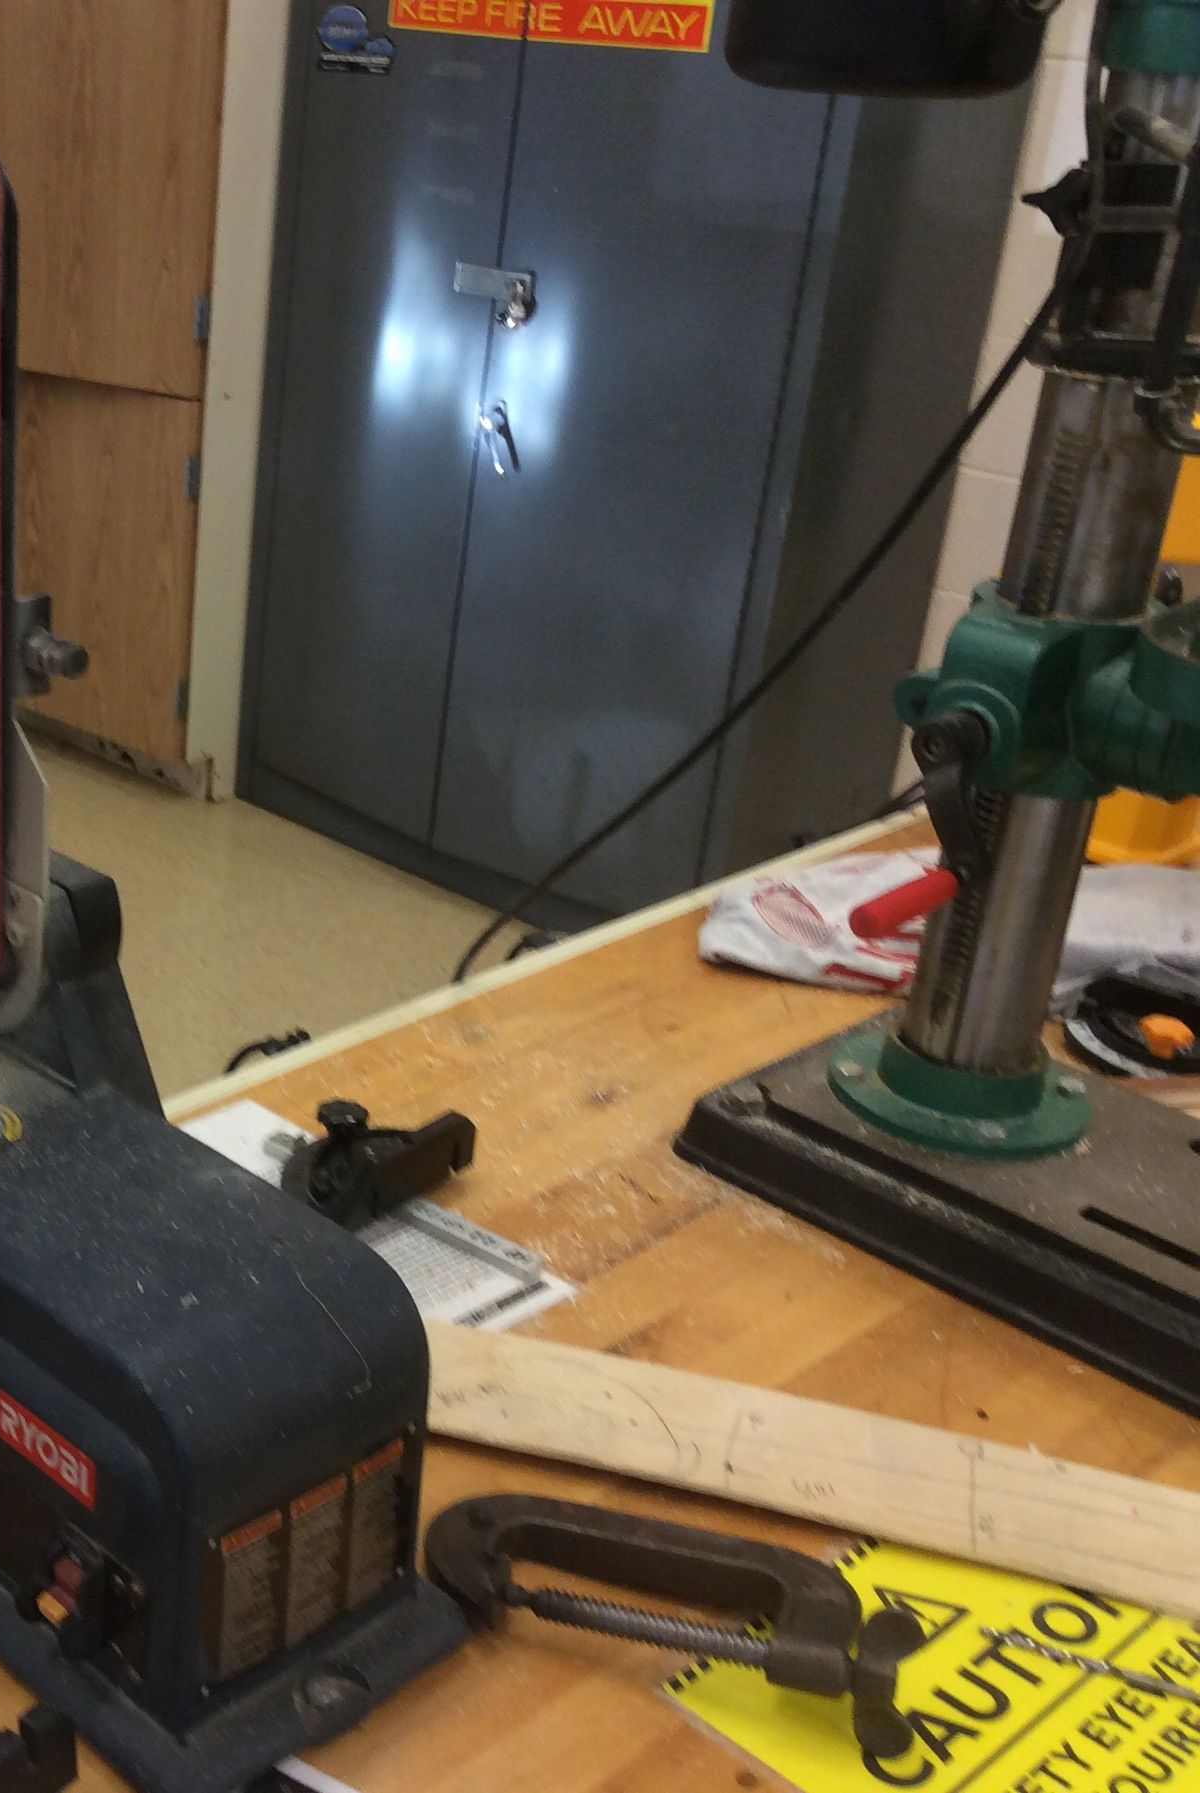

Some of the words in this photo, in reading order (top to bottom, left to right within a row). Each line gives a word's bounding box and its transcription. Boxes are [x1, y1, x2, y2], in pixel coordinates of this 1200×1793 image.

[396, 0, 478, 24] KEEP
[484, 0, 564, 32] FIRE
[577, 4, 701, 41] AWAY
[862, 1584, 1122, 1787] CAUTIO
